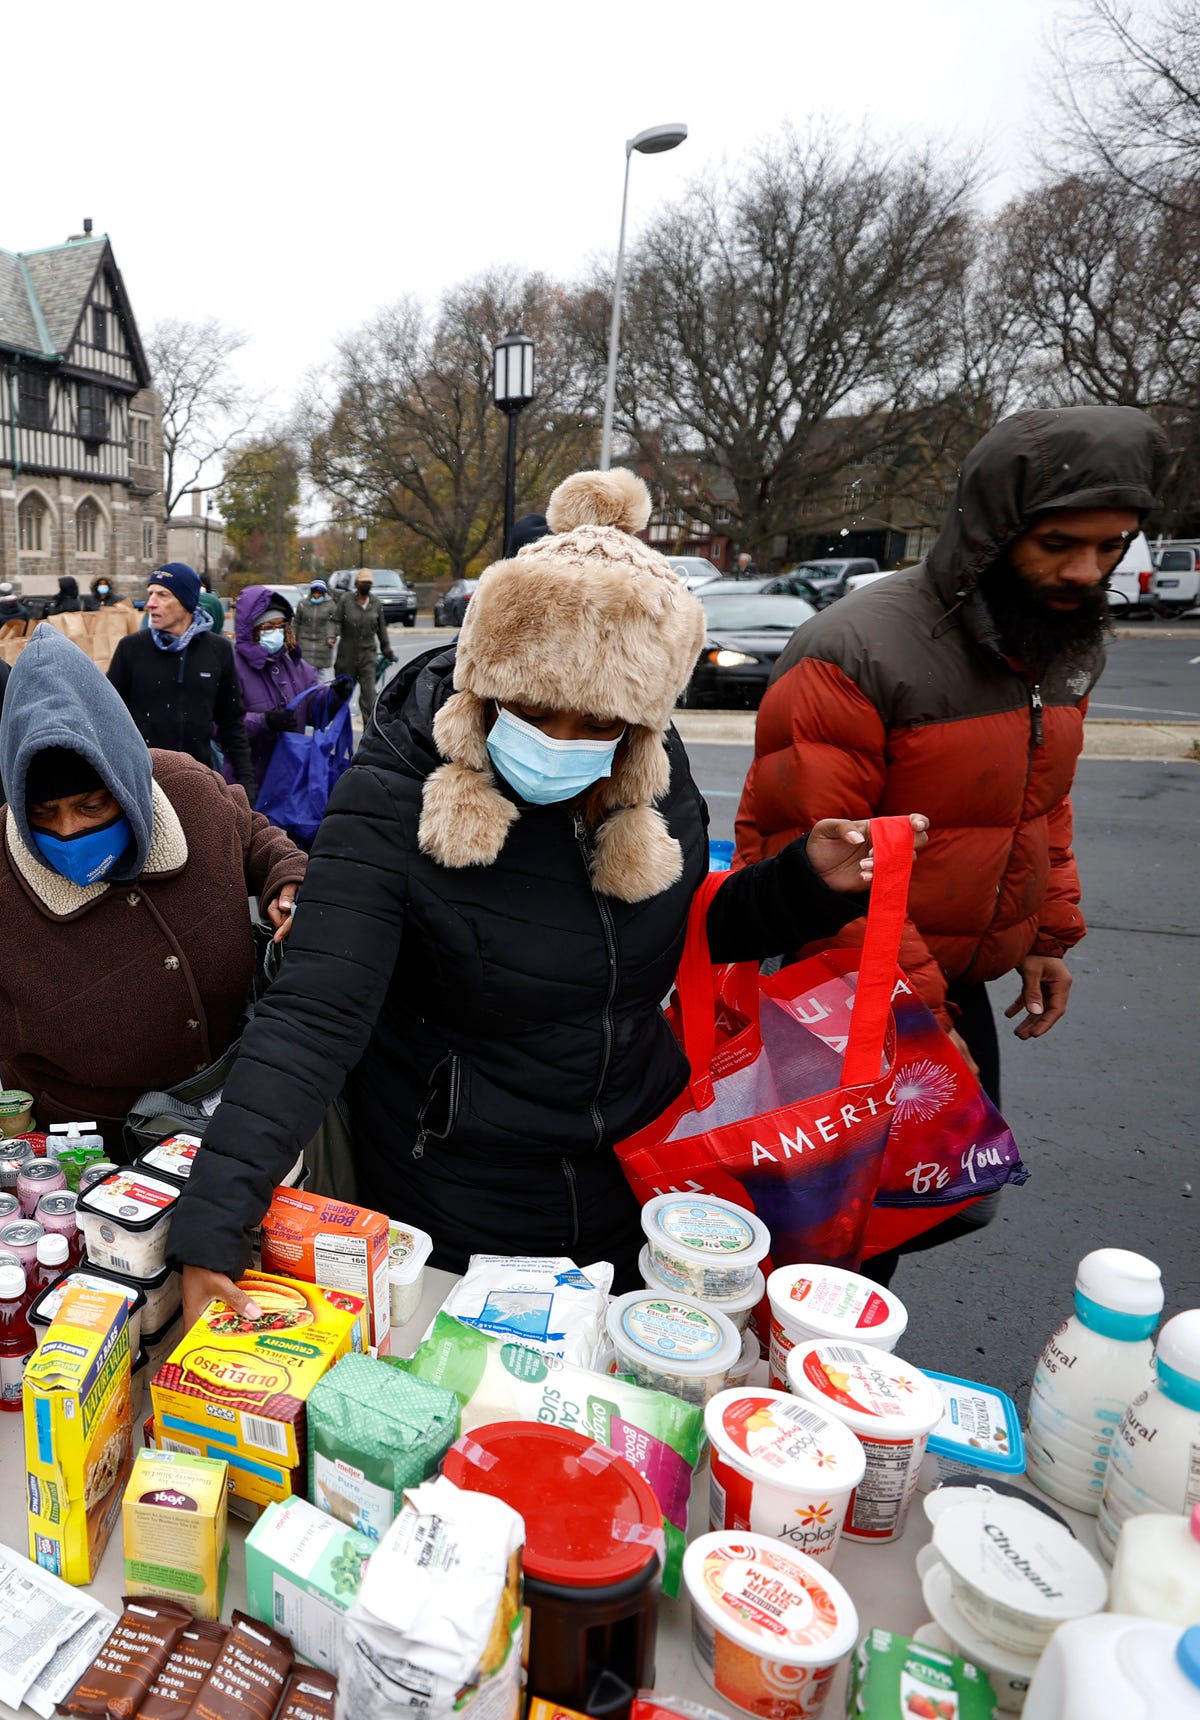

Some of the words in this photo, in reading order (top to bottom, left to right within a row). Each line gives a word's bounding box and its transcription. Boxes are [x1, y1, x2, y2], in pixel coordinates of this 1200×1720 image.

[324, 1203, 360, 1216] Original
[319, 1212, 357, 1227] Ben's
[315, 1252, 339, 1261] Calories
[351, 1257, 366, 1265] 160
[635, 1312, 713, 1342] GORGONZOLA
[253, 1347, 288, 1361] SHELLS
[263, 1338, 314, 1355] CRUNCHY
[287, 1357, 304, 1368] 12
[636, 1434, 650, 1461] true
[338, 1476, 360, 1493] Pure
[985, 1524, 1065, 1600] Chobani
[745, 1568, 803, 1607] CREAM
[747, 1580, 792, 1611] SOUR
[109, 1638, 118, 1646] 14
[118, 1640, 149, 1653] Peanuts
[115, 1627, 122, 1635] 3
[122, 1629, 138, 1640] Egg
[138, 1632, 165, 1647] Whites
[101, 1648, 108, 1656] 2
[108, 1650, 131, 1662] Dates
[170, 1653, 183, 1663] gg
[184, 1655, 212, 1669] White
[94, 1659, 106, 1669] No
[107, 1663, 122, 1673] B.S.
[165, 1662, 202, 1679] Peanuts
[222, 1656, 233, 1666] 14
[233, 1661, 270, 1687] Peanuts
[227, 1645, 234, 1653] 3
[234, 1648, 253, 1664] Egg
[253, 1659, 284, 1684] Whites
[158, 1674, 185, 1688] Dates
[216, 1665, 224, 1674] 2
[224, 1669, 252, 1690] Dates
[160, 1687, 179, 1699] B.S.
[210, 1676, 225, 1690] No
[225, 1684, 244, 1701] B.S.
